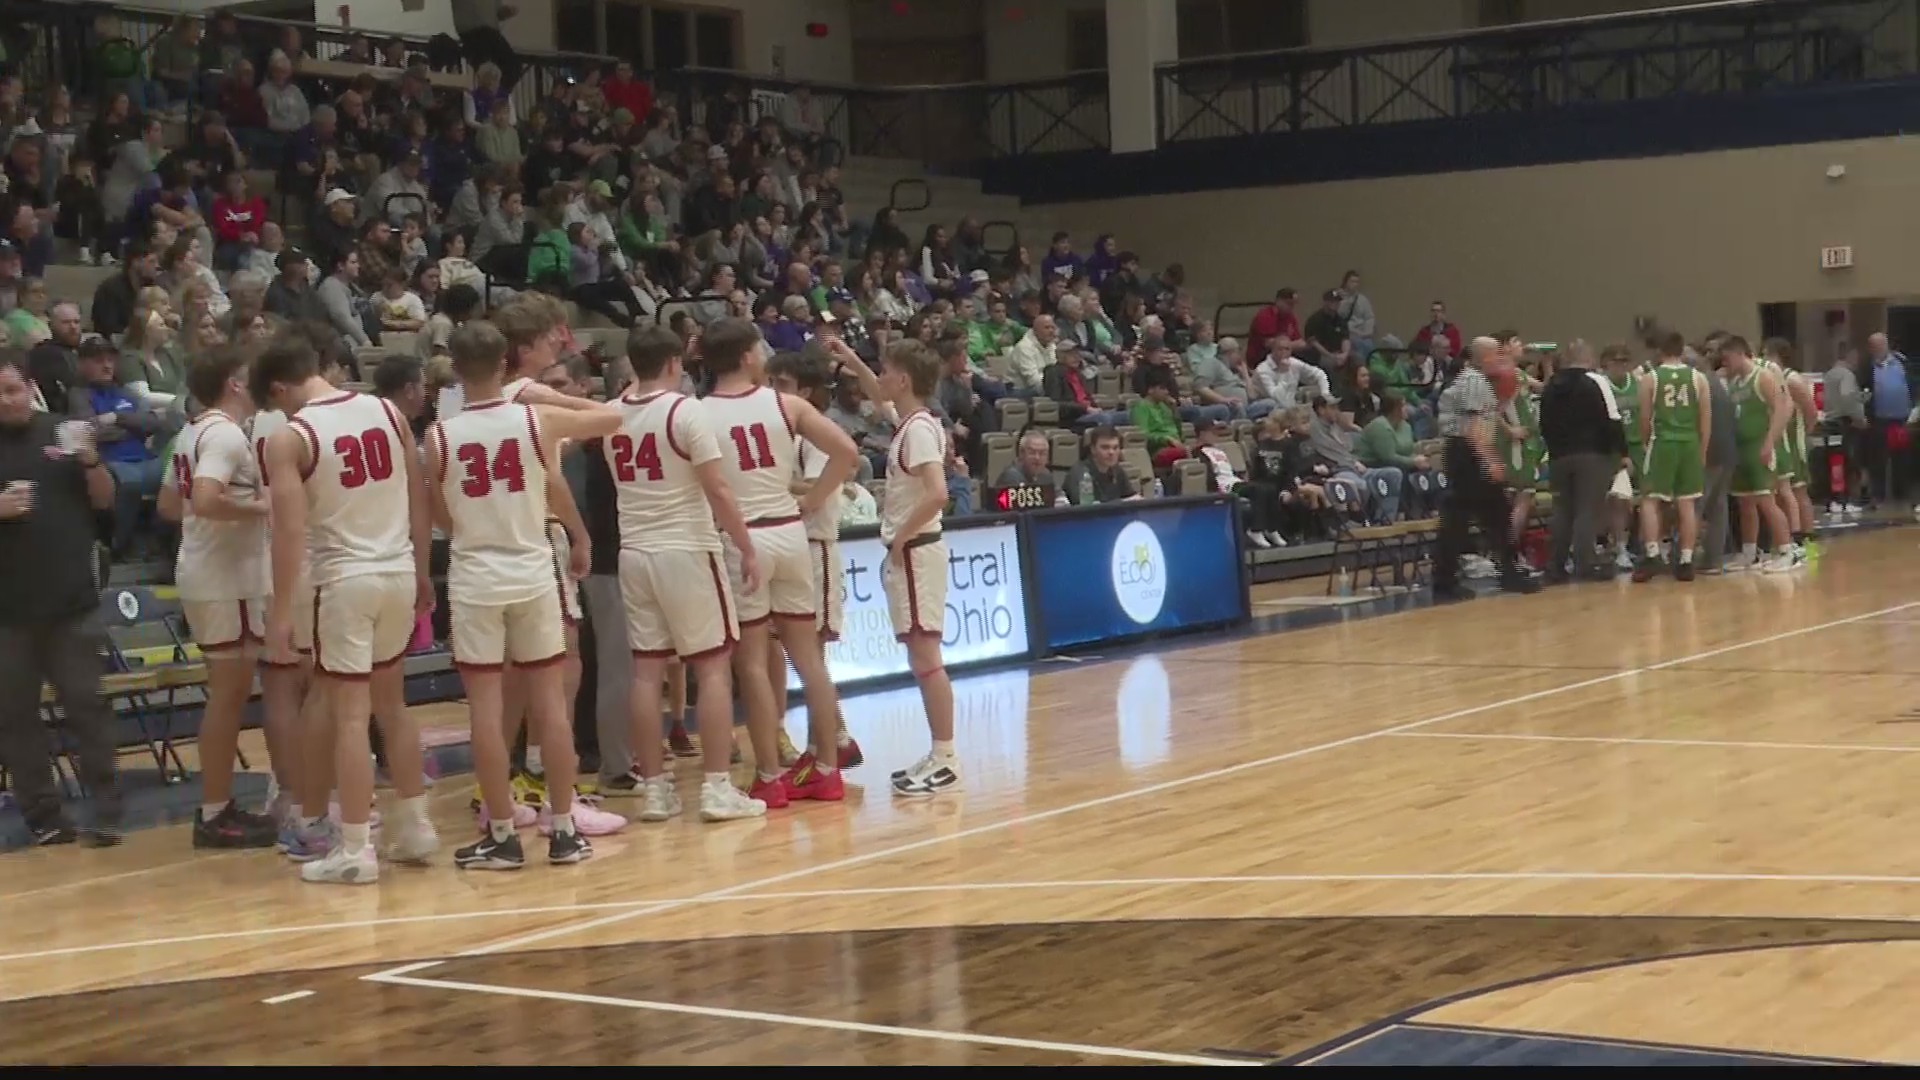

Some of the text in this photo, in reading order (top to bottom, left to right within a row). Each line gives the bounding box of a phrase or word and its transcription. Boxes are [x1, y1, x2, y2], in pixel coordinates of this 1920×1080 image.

[1664, 384, 1690, 408] 24
[334, 428, 393, 488] 30
[458, 438, 525, 497] 34
[612, 433, 664, 482] 24
[730, 423, 776, 471] 11
